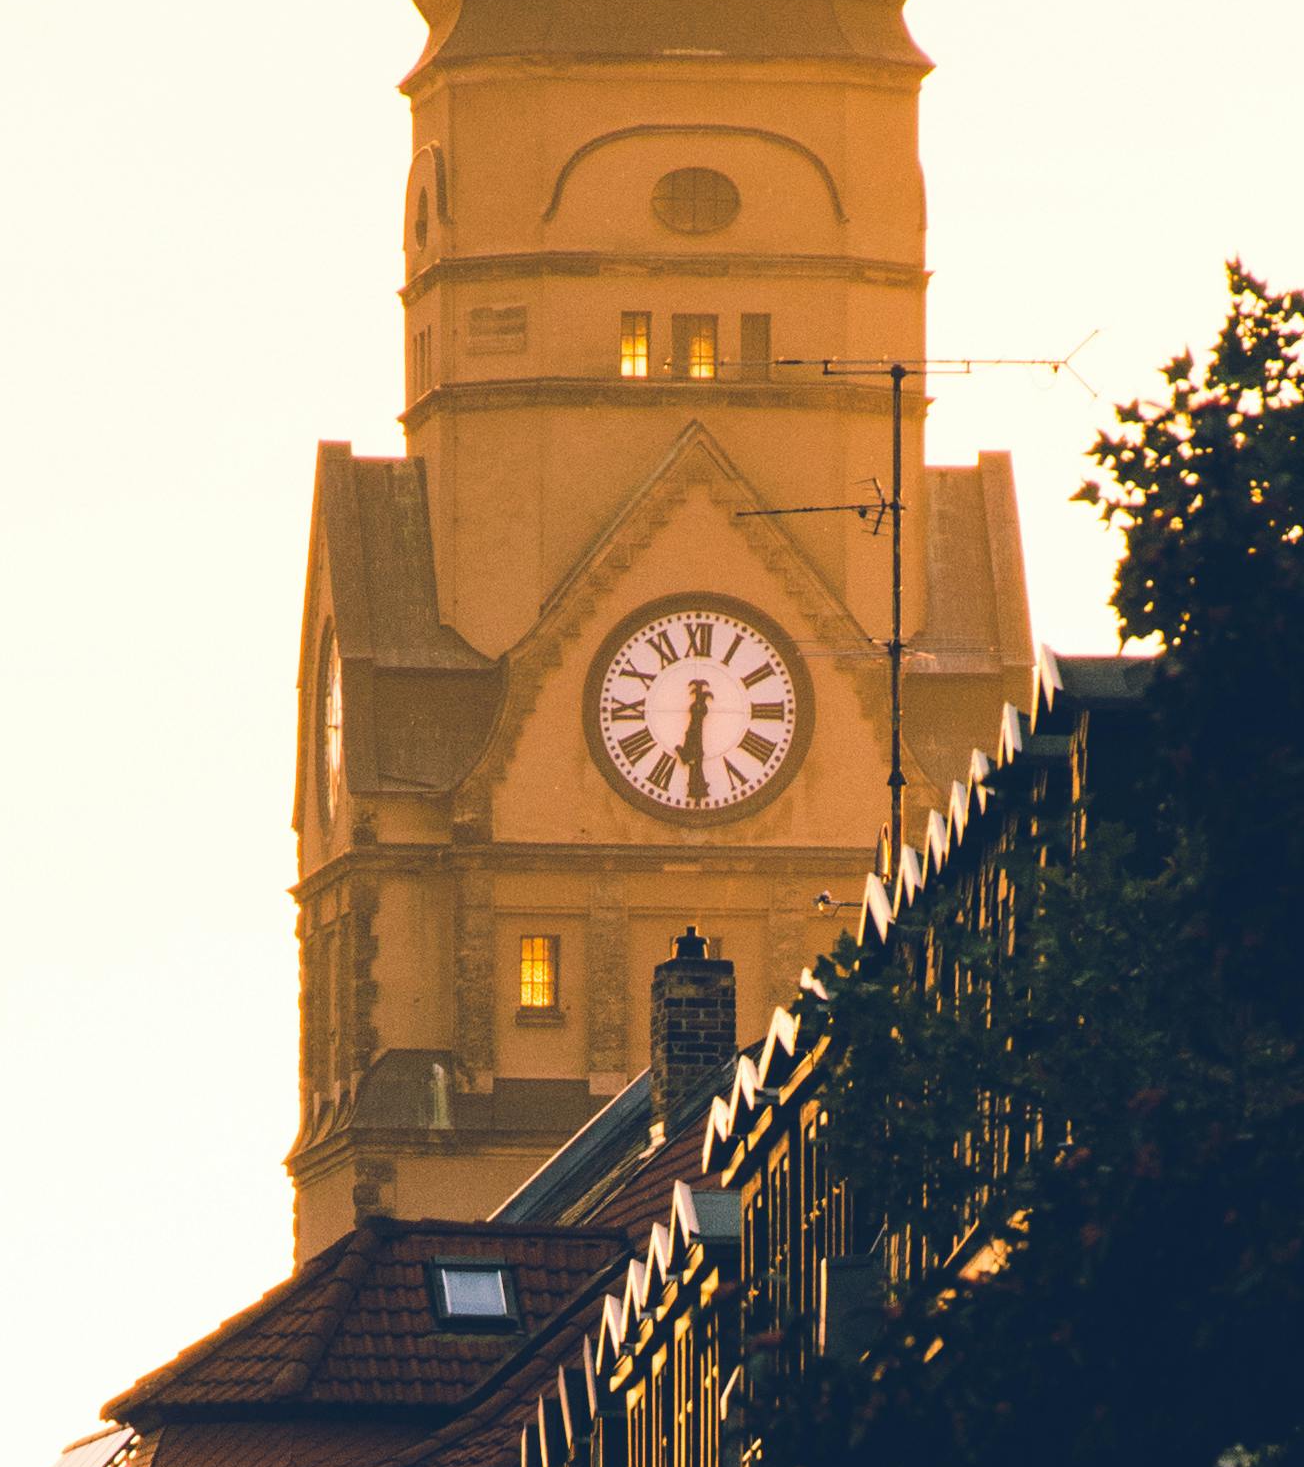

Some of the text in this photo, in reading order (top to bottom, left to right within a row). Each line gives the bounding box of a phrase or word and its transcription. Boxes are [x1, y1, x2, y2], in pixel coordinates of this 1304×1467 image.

[646, 629, 680, 669] XI
[684, 623, 714, 658] XII
[721, 633, 745, 666] I
[619, 658, 657, 690] X
[741, 661, 776, 689] II
[612, 696, 645, 722] IX
[751, 701, 784, 722] III
[646, 750, 677, 791] VII
[723, 756, 749, 791] V
